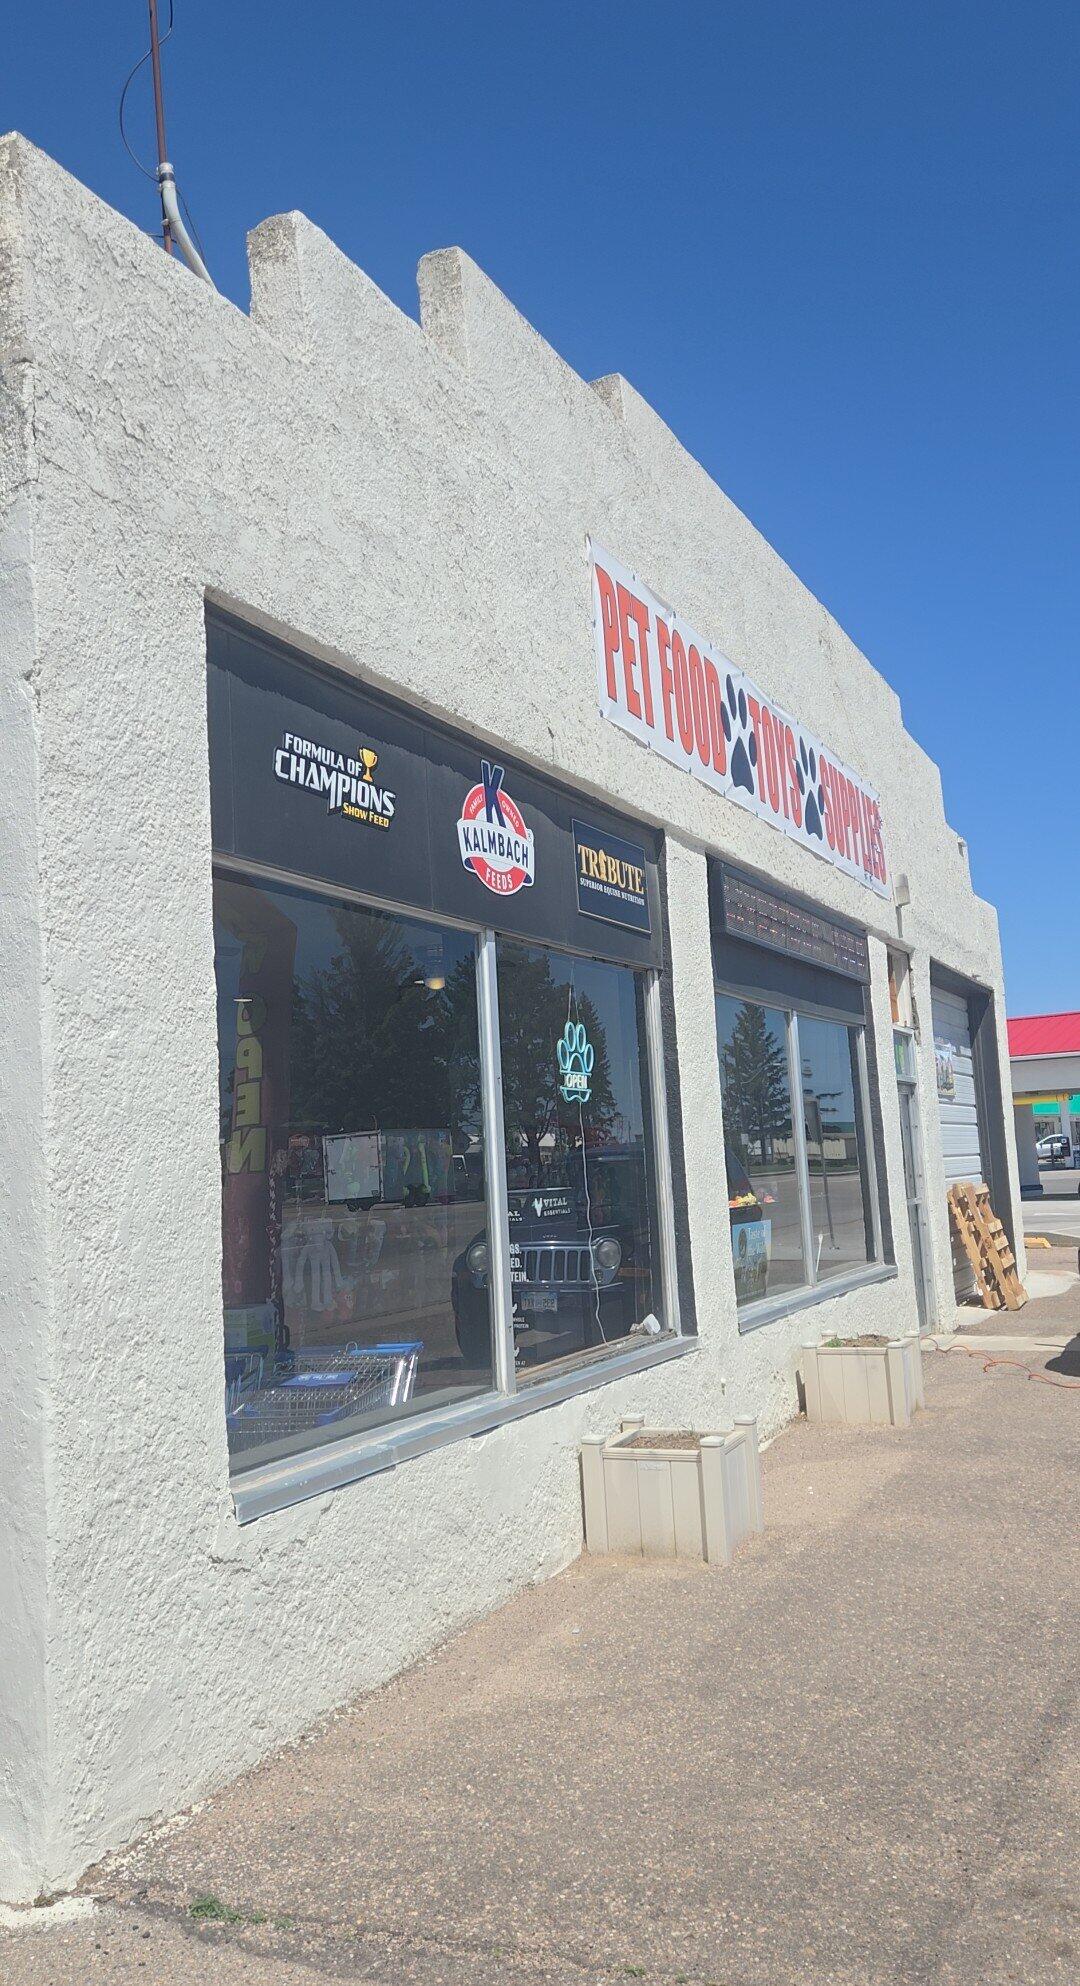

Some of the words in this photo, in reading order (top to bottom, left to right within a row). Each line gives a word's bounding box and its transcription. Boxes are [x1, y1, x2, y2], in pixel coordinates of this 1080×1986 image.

[595, 562, 655, 729] PET
[656, 614, 727, 776] FOOD
[747, 693, 803, 829] TOYS
[819, 754, 887, 886] SUPPLIES
[284, 732, 344, 772] FORMULA
[347, 758, 363, 777] OF
[275, 749, 397, 817] CHAMPIONS
[343, 802, 368, 821] SHOW
[369, 811, 390, 828] FEED
[501, 800, 520, 828] OWNED
[463, 827, 529, 869] KALMBACH
[485, 868, 513, 890] FEEDS
[578, 844, 645, 895] TRIBUTE
[580, 878, 604, 892] SUPERIOR
[604, 885, 622, 898] EQUINE
[621, 891, 645, 906] NUTRITION
[565, 1073, 587, 1089] OPEN
[543, 1197, 568, 1208] VITAL
[509, 1243, 522, 1255] GS.
[510, 1257, 523, 1269] ED.
[510, 1271, 530, 1283] TEIN.
